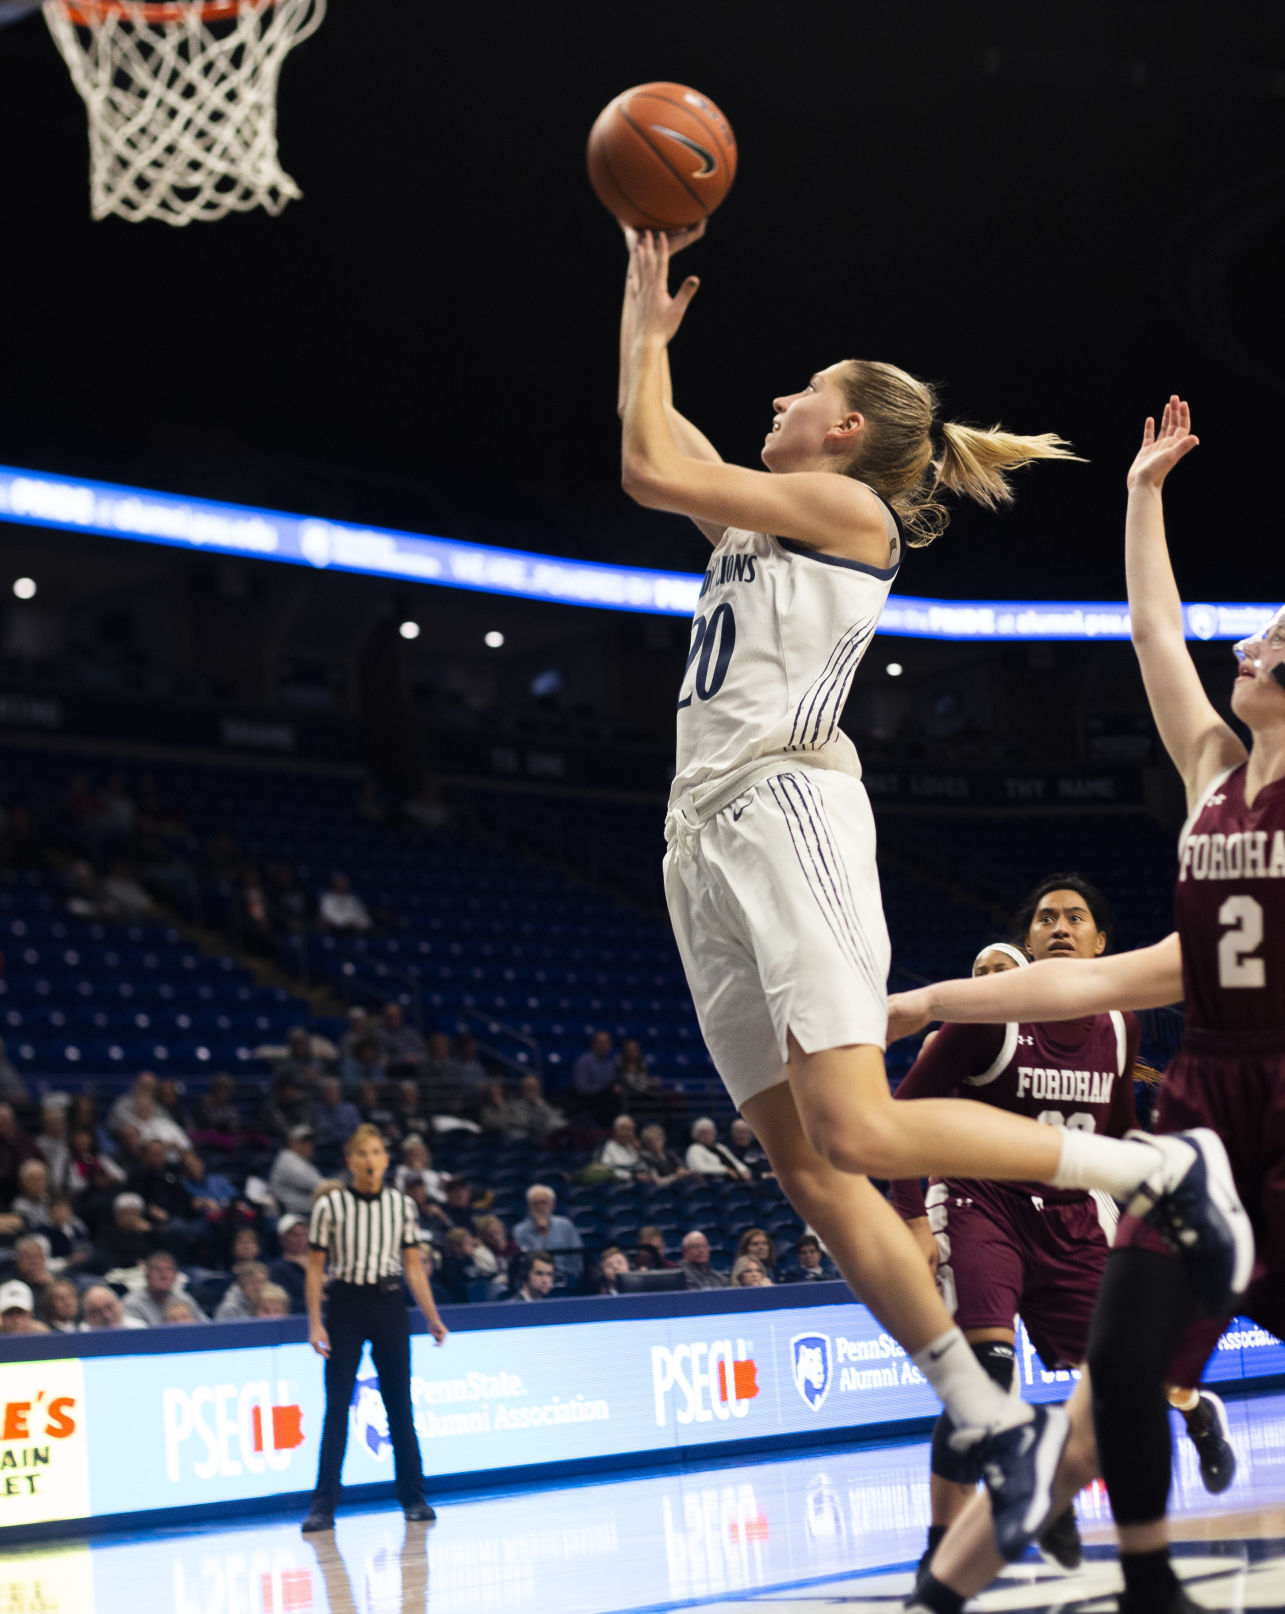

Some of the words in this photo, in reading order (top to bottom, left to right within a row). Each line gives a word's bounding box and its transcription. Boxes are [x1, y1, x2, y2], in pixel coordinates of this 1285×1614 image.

[677, 602, 736, 709] 20
[1218, 895, 1265, 988] 2
[1017, 1066, 1114, 1103] FORDHAM
[412, 1403, 491, 1438] Alumni
[494, 1394, 610, 1431] Association
[651, 1338, 750, 1427] PSECU
[839, 1362, 899, 1391] Alumni
[163, 1378, 292, 1482] PSECU
